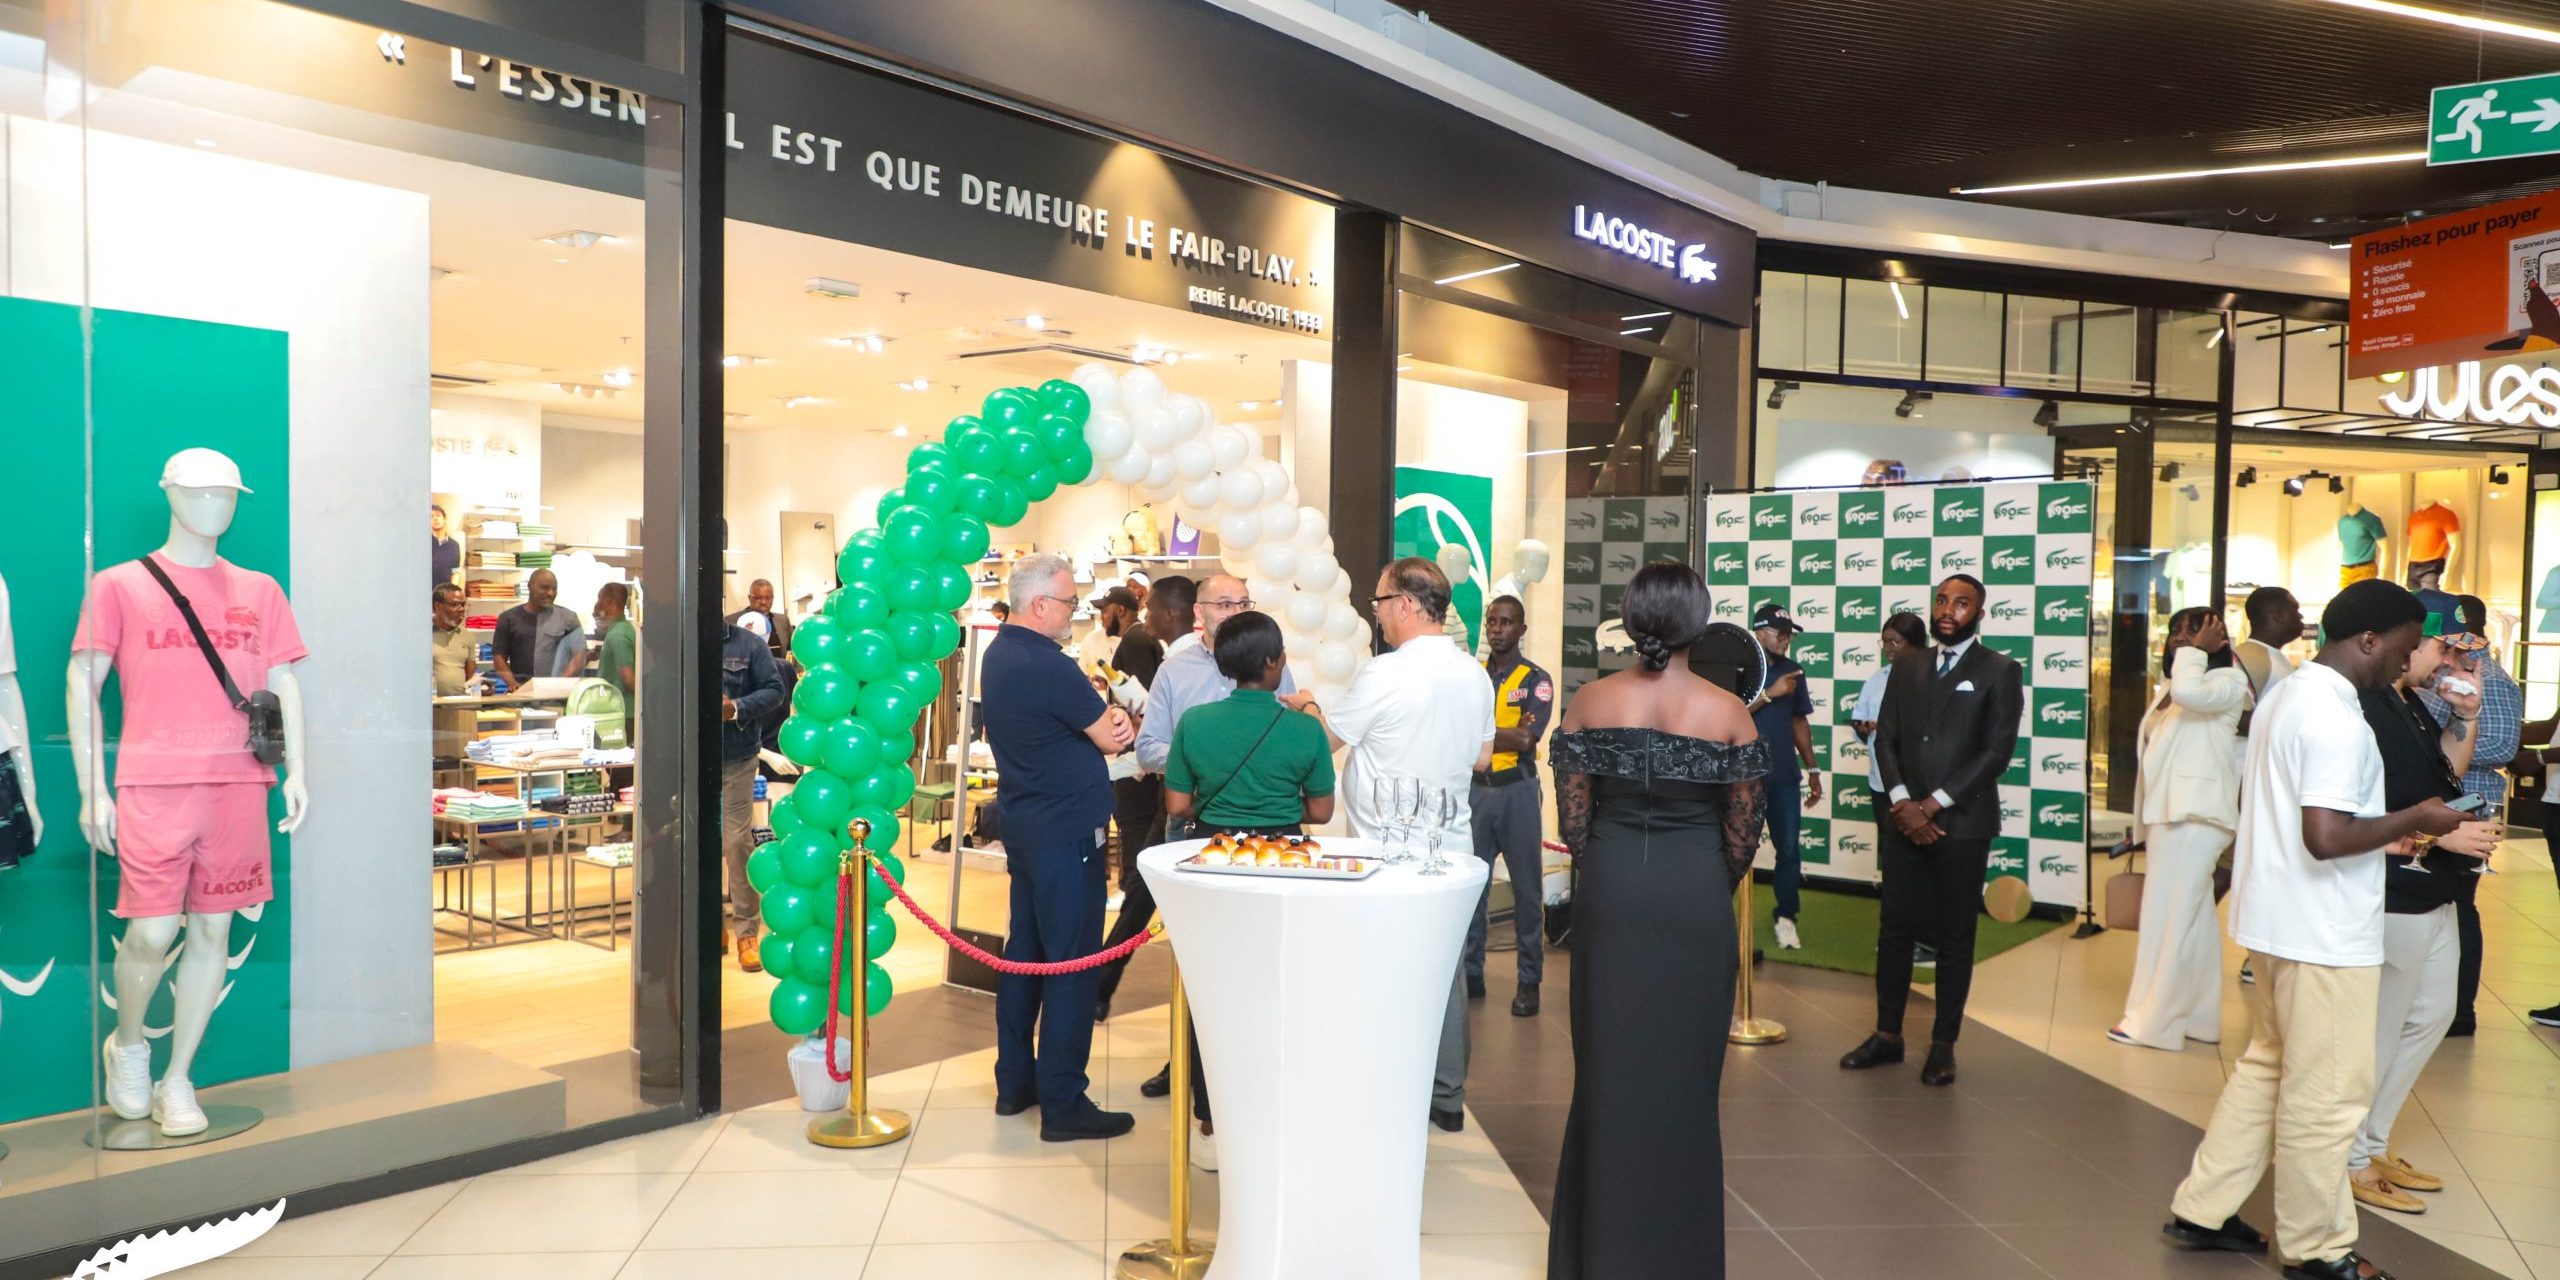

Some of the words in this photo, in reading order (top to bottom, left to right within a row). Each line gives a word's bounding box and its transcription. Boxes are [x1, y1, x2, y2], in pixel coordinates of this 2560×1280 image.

[772, 124, 842, 172] EST
[866, 151, 940, 197] QUE
[961, 173, 1108, 238] DEMEURE
[1126, 215, 1154, 249] LE
[1169, 227, 1301, 285] FAIR-PLAY.
[1575, 204, 1675, 269] LACOSTE
[2364, 232, 2432, 258] Flashez
[2436, 221, 2480, 245] pour
[2485, 207, 2541, 234] payer
[2373, 259, 2412, 274] Sécurisé
[2373, 272, 2405, 285] Rapide
[2381, 282, 2410, 294] soucis
[2372, 298, 2384, 307] de
[2386, 290, 2426, 304] monnaie
[1189, 285, 1226, 309] RENÉ
[1230, 294, 1290, 323] LACOSTE
[1293, 310, 1324, 332] 1933
[2372, 307, 2394, 318] Zéro
[2395, 303, 2416, 313] frais
[431, 437, 473, 454] STE
[203, 873, 264, 896] LACOSTE
